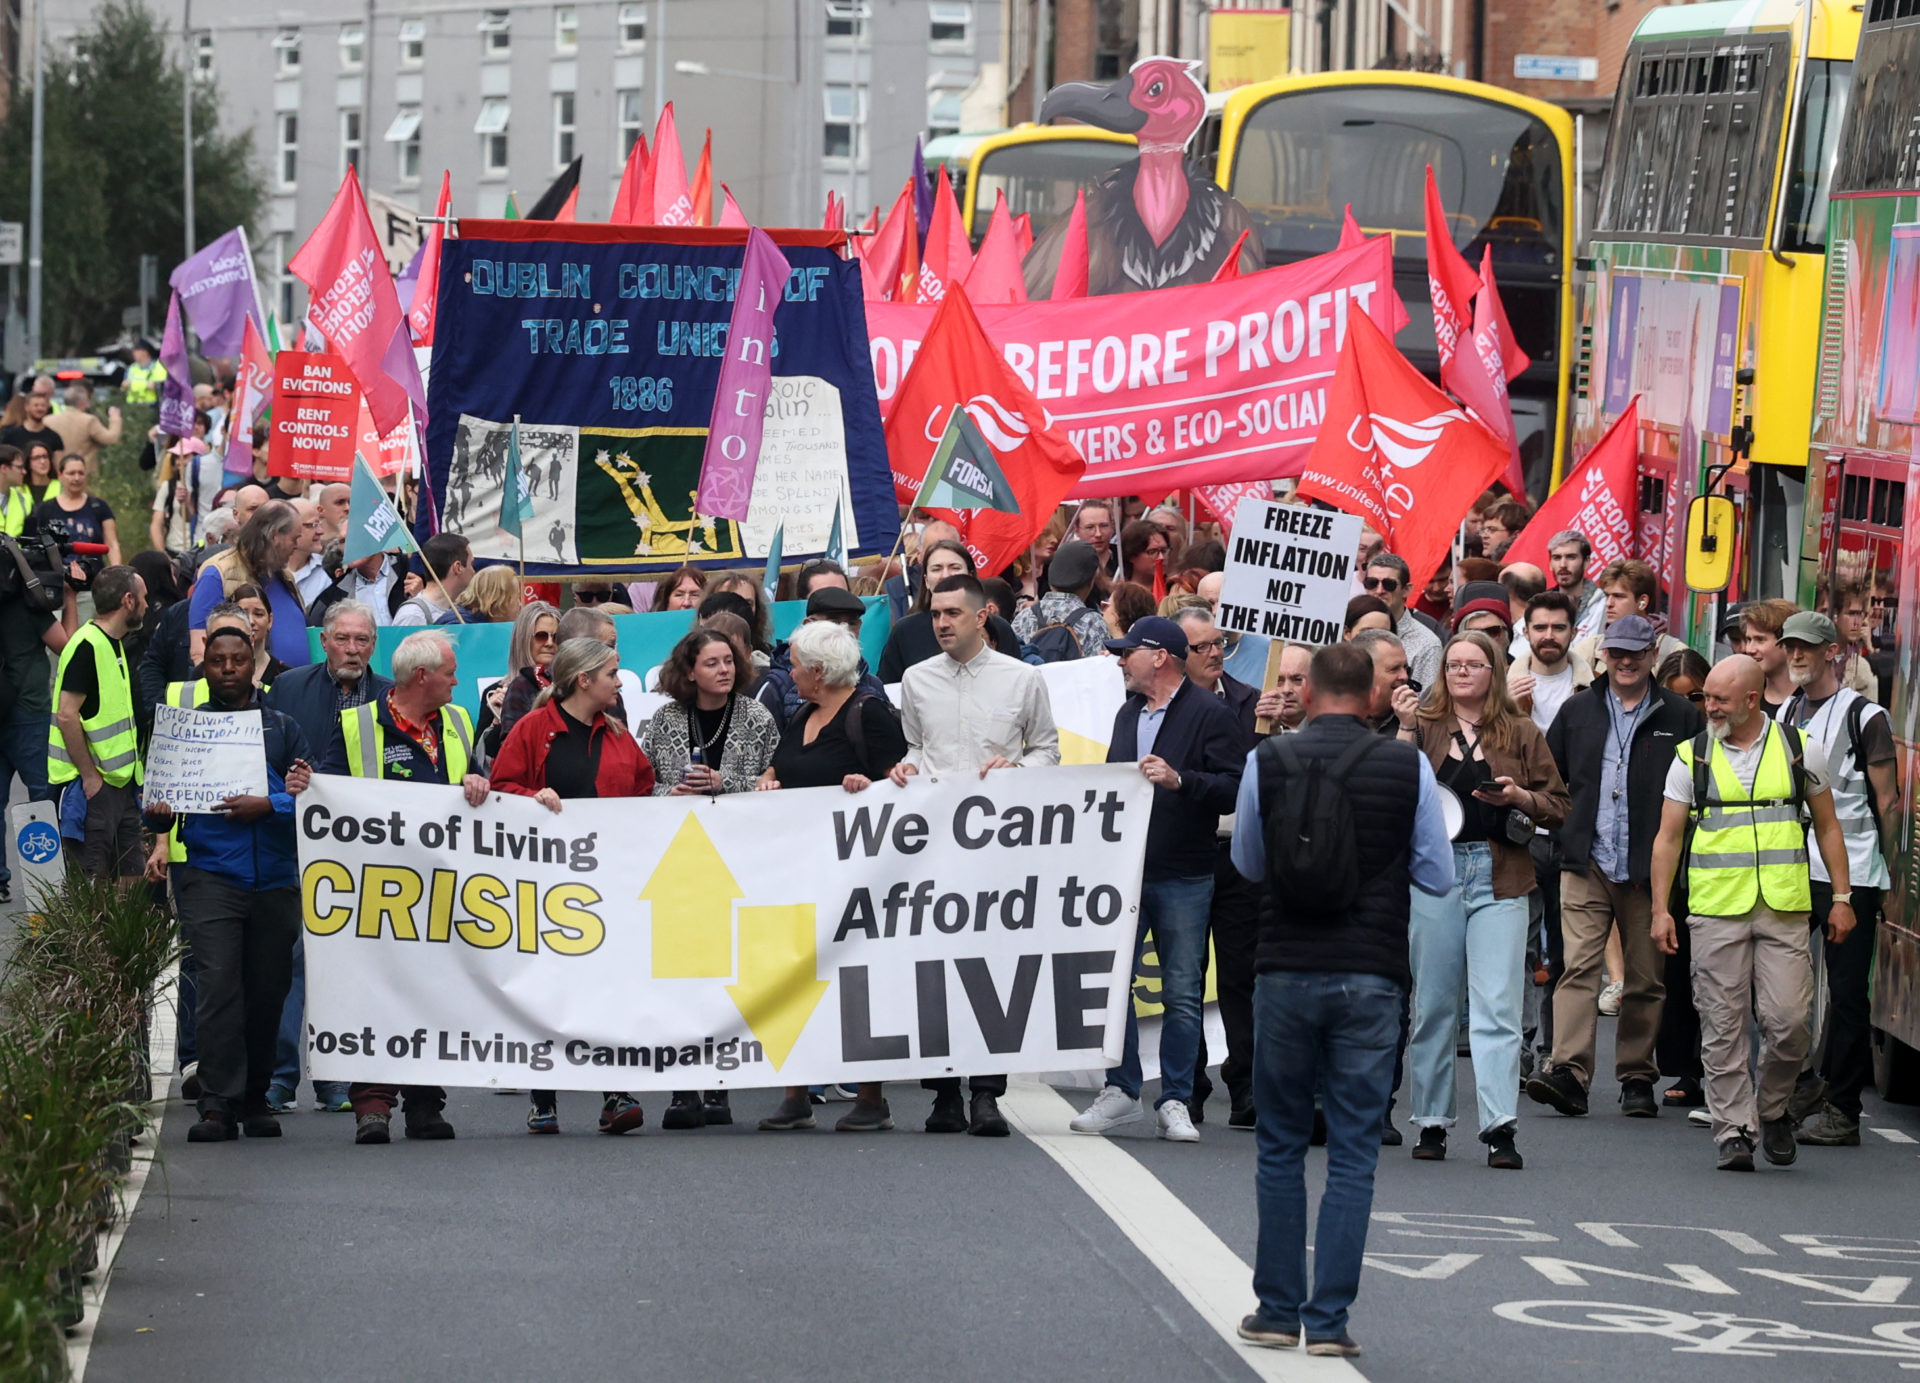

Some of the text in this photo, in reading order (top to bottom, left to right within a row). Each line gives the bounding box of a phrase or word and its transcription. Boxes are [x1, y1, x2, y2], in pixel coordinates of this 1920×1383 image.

[471, 259, 830, 301] DUBLIN COUNCI OF
[522, 318, 779, 357] TRADE UNIO
[1004, 326, 1190, 400] BEFORE
[1204, 280, 1377, 378] PROFIT
[282, 377, 352, 395] EVICTIONS
[303, 364, 332, 378] BAN
[719, 279, 769, 463] into
[770, 381, 816, 399] ROIC
[609, 376, 673, 412] 1886
[278, 421, 349, 438] CONTROLS
[297, 408, 331, 421] RENT
[763, 427, 821, 438] EEMED
[1069, 387, 1326, 465] KERS & ECO-SOCIAL
[292, 437, 331, 451] NOW!
[775, 471, 801, 482] HER
[1264, 506, 1333, 540] FREEZE
[1595, 487, 1635, 557] PEOPLE
[1234, 537, 1350, 582] INFLATION
[1266, 578, 1306, 604] NOT
[1220, 602, 1341, 645] THE NATION
[193, 711, 235, 726] LIVING
[302, 803, 598, 872] Cost of Living
[832, 789, 1125, 861] We Can't
[301, 859, 606, 956] CRISIS
[832, 875, 1123, 943] Afford to
[838, 950, 1117, 1063] LIVE
[386, 1028, 427, 1059] of
[438, 1030, 554, 1071] Living
[564, 1036, 763, 1073] Campaign
